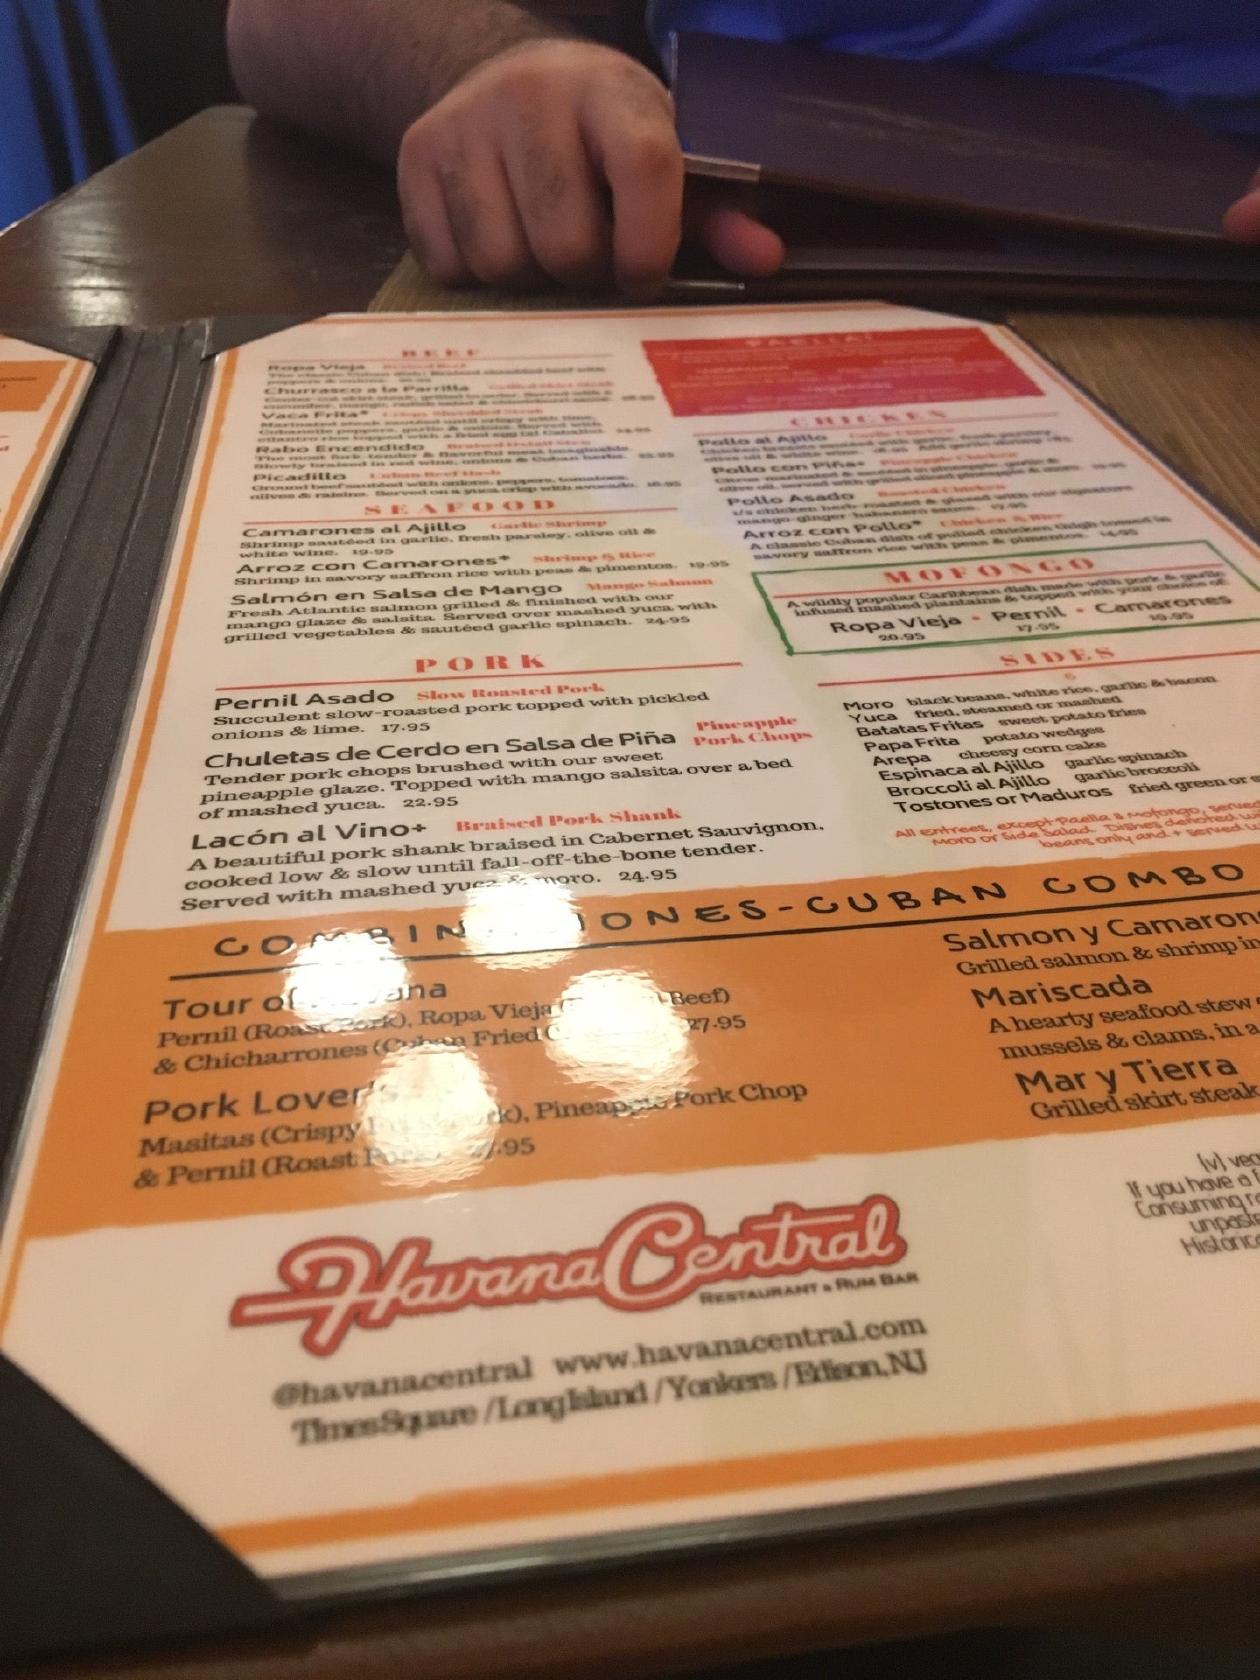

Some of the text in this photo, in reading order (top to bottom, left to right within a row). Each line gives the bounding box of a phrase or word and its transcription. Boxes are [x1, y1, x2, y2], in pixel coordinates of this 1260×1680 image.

[255, 443, 425, 453] Rabo Encendido
[253, 472, 346, 481] Picadillo
[364, 500, 555, 514] SEAFOOD
[726, 492, 854, 505] Pollo Asado
[242, 522, 466, 537] Camarones al Ajillo
[743, 529, 802, 538] Arroz
[808, 527, 849, 535] con
[239, 548, 288, 558] white
[292, 547, 338, 556] wine.
[236, 564, 304, 573] Arroz
[311, 562, 355, 570] con
[883, 559, 1093, 583] MOFONGO
[230, 585, 562, 605] Salmón en Salsa de Mango
[829, 596, 1232, 633] Ropa Vieja Pernil Camarones
[878, 632, 925, 640] 20.95
[415, 655, 544, 672] PORK
[1000, 649, 1114, 665] SIDES
[214, 683, 604, 710] Pernil Asado Slow Roasted Pork
[842, 701, 893, 710] Moro
[696, 716, 796, 731] Pineapple
[848, 713, 898, 722] Yuca
[856, 720, 984, 736] Batatas Fritas
[211, 722, 430, 740] onions & lime. 17.95
[693, 731, 813, 746] Pork Chops
[204, 731, 676, 767] Chuletas de Cerdo en Salsa de Piña
[864, 737, 960, 752] Papa Frita
[873, 751, 931, 766] Arepa
[878, 759, 1044, 780] Espinaca al Ajillo
[886, 762, 1200, 796] Broccoli al Ajillo garlic broccoli
[894, 786, 1112, 813] Tostones or Maduros
[456, 808, 681, 831] Braised Pork Shank
[186, 822, 823, 871] A beautiful pork shank braised in Cabernet Sauvignon,
[191, 822, 426, 849] Lacón al Vino+
[1043, 864, 1244, 897] COMBO
[942, 928, 1075, 951] Salmon
[1080, 926, 1098, 945] y
[956, 942, 1238, 975] Grilled salmon & shrimp
[970, 976, 1152, 1008] Mariscada
[163, 998, 252, 1019] Tour
[988, 998, 1251, 1034] A hearty seafood stew
[156, 1003, 552, 1047] Pernil Ropa Vieja
[152, 1015, 747, 1074] & Chicharrones Fried 27.95
[998, 1023, 1244, 1058] mussels & clams, in
[1015, 1059, 1238, 1094] Mar y Tierra
[144, 1094, 238, 1123] Pork
[1030, 1082, 1260, 1118] Grilled skirt steak
[138, 1083, 808, 1156] Masitas (Crispy Pork Chop
[134, 1147, 362, 1188] & Pernil (Roast
[230, 1194, 907, 1357] Havana Central
[273, 1320, 927, 1404] @havanacentral www.havanacentral.com
